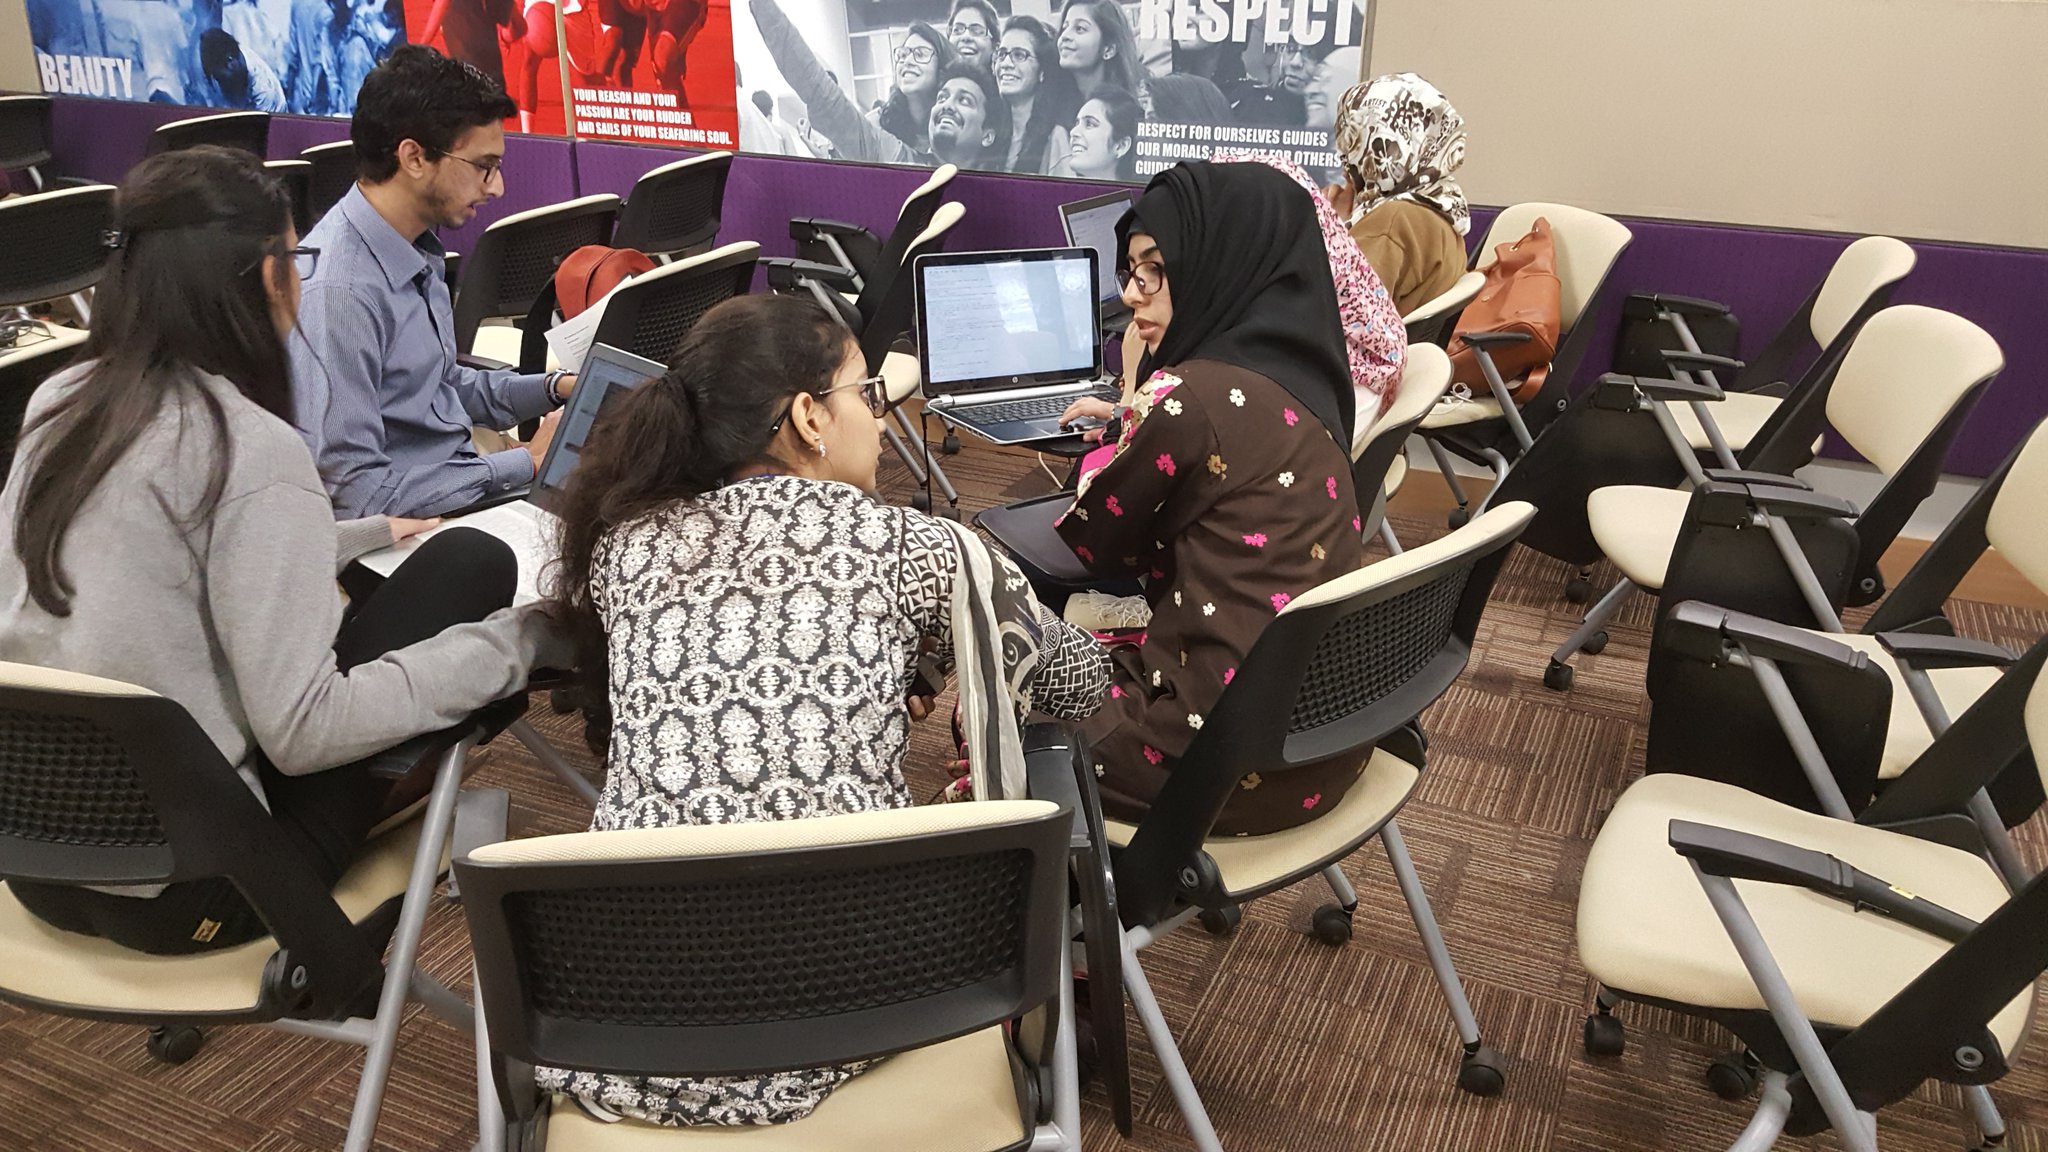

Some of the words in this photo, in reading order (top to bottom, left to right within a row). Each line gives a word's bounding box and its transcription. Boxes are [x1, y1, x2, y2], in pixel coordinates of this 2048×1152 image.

[1140, 0, 1353, 45] RESPECT
[38, 53, 132, 98] BEAUTY
[573, 88, 597, 102] YOUR
[598, 90, 632, 104] REASON
[633, 92, 651, 105] AND
[652, 93, 677, 107] YOUR
[1363, 98, 1387, 108] ARTIST
[575, 105, 612, 119] PASSION
[613, 107, 631, 120] ARE
[631, 108, 655, 122] YOUR
[655, 110, 692, 125] RUDDER
[577, 121, 595, 134] AND
[596, 122, 620, 136] SAILS
[621, 124, 633, 137] OF
[633, 125, 657, 139] YOUR
[658, 127, 706, 143] SEAFARING
[706, 130, 733, 145] SOUL.
[1137, 122, 1187, 139] RESPECT
[1189, 125, 1211, 141] FOR
[1213, 126, 1280, 144] OURSELVES
[1282, 130, 1328, 148] GUIDES
[1136, 141, 1161, 157] OUR
[1162, 143, 1213, 161] MORALS;
[1294, 151, 1341, 168] OTHERS
